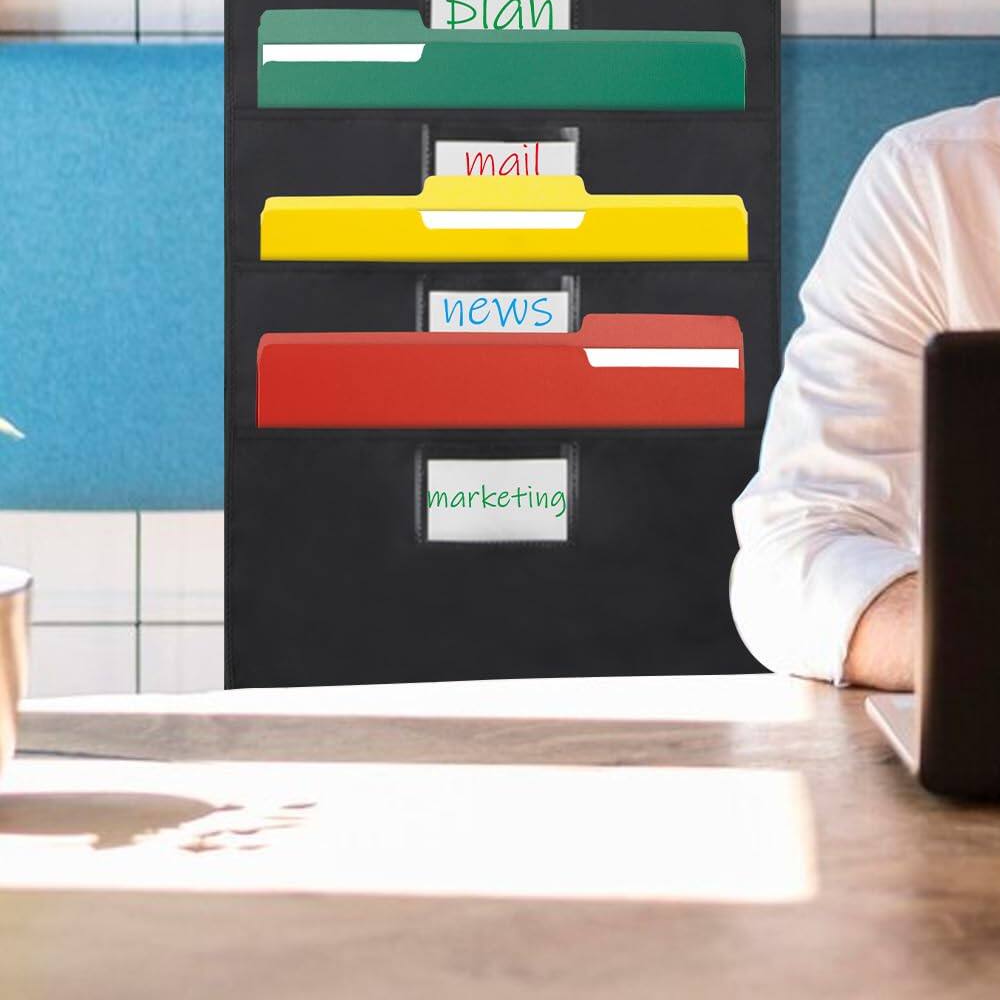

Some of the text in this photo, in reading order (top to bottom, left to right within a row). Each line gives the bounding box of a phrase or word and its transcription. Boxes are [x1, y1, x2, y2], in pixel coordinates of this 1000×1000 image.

[464, 139, 541, 177] mail
[443, 297, 553, 328] news
[427, 484, 567, 518] marketing
